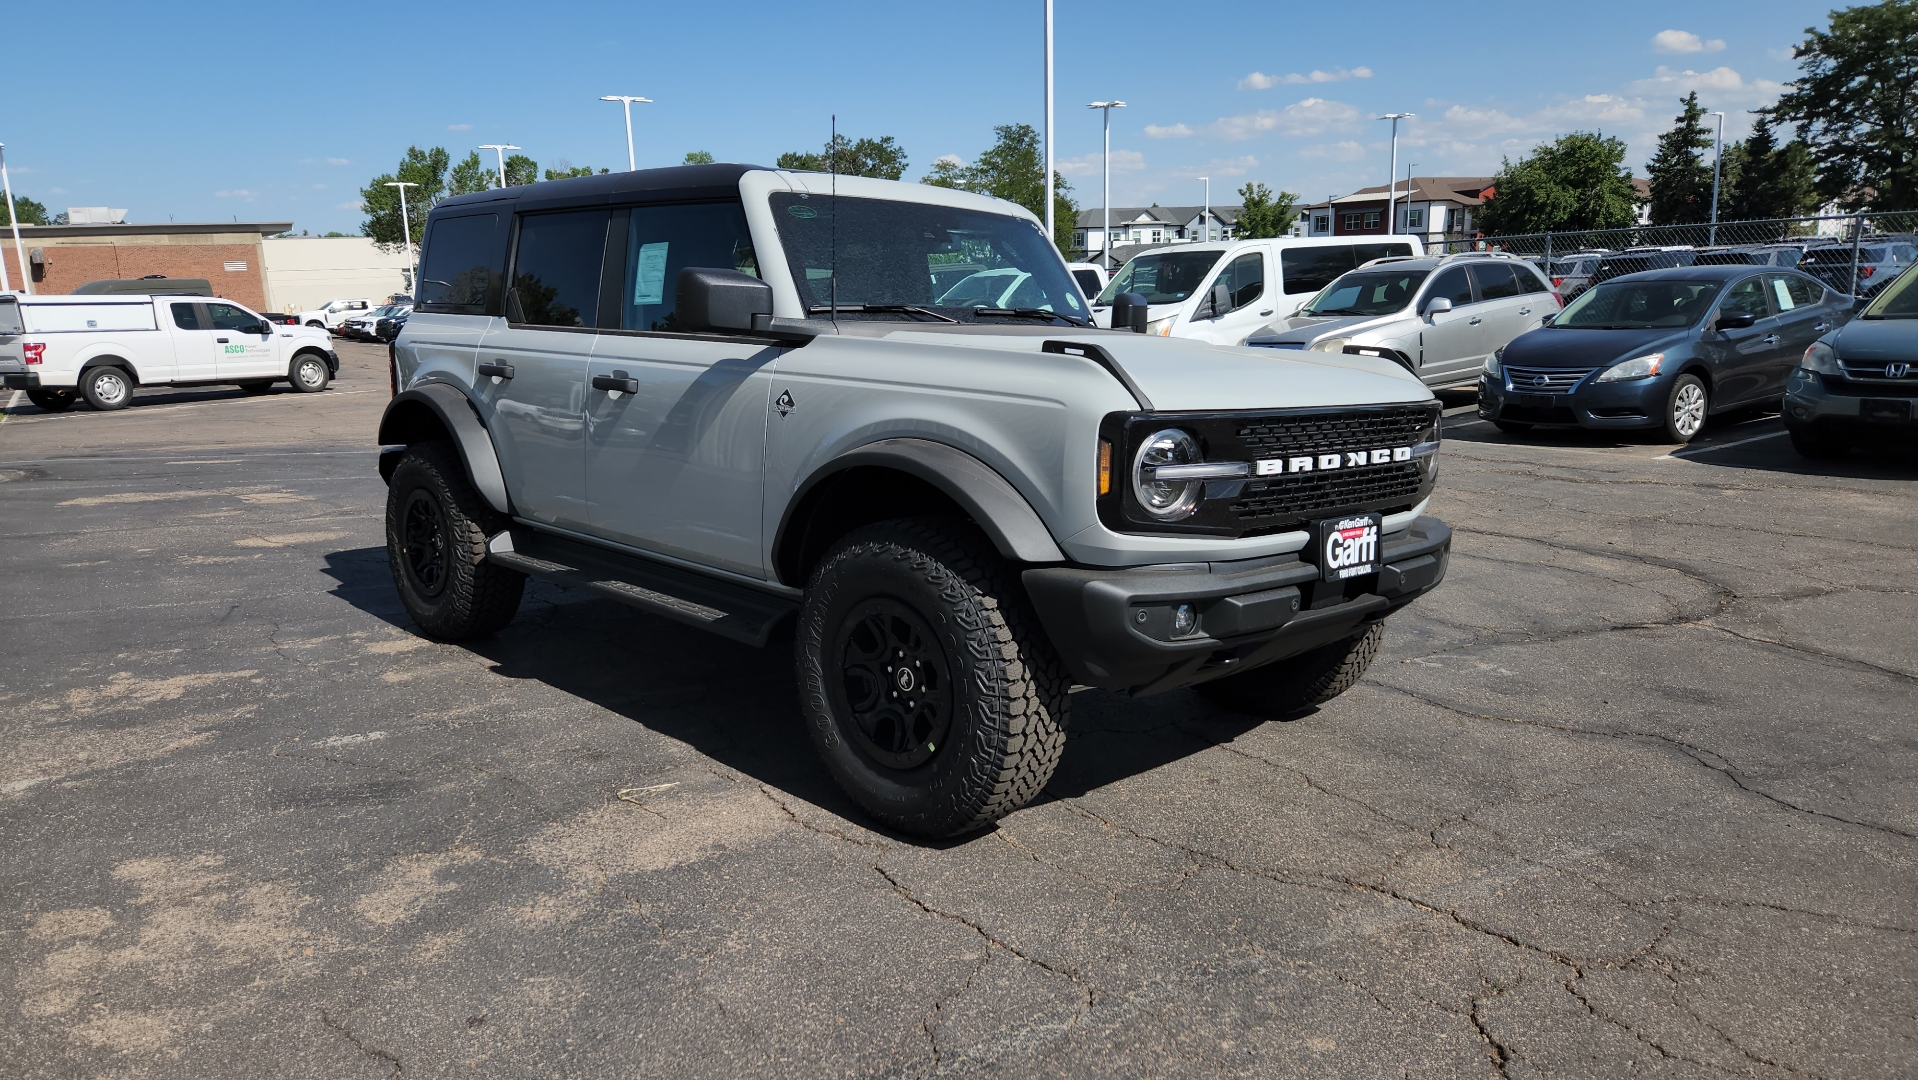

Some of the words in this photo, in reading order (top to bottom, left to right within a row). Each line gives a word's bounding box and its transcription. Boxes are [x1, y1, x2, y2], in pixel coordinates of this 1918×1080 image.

[225, 345, 245, 354] ASCO
[1256, 447, 1411, 476] BRONCO
[1355, 516, 1369, 527] Garff
[1327, 526, 1377, 569] Garff
